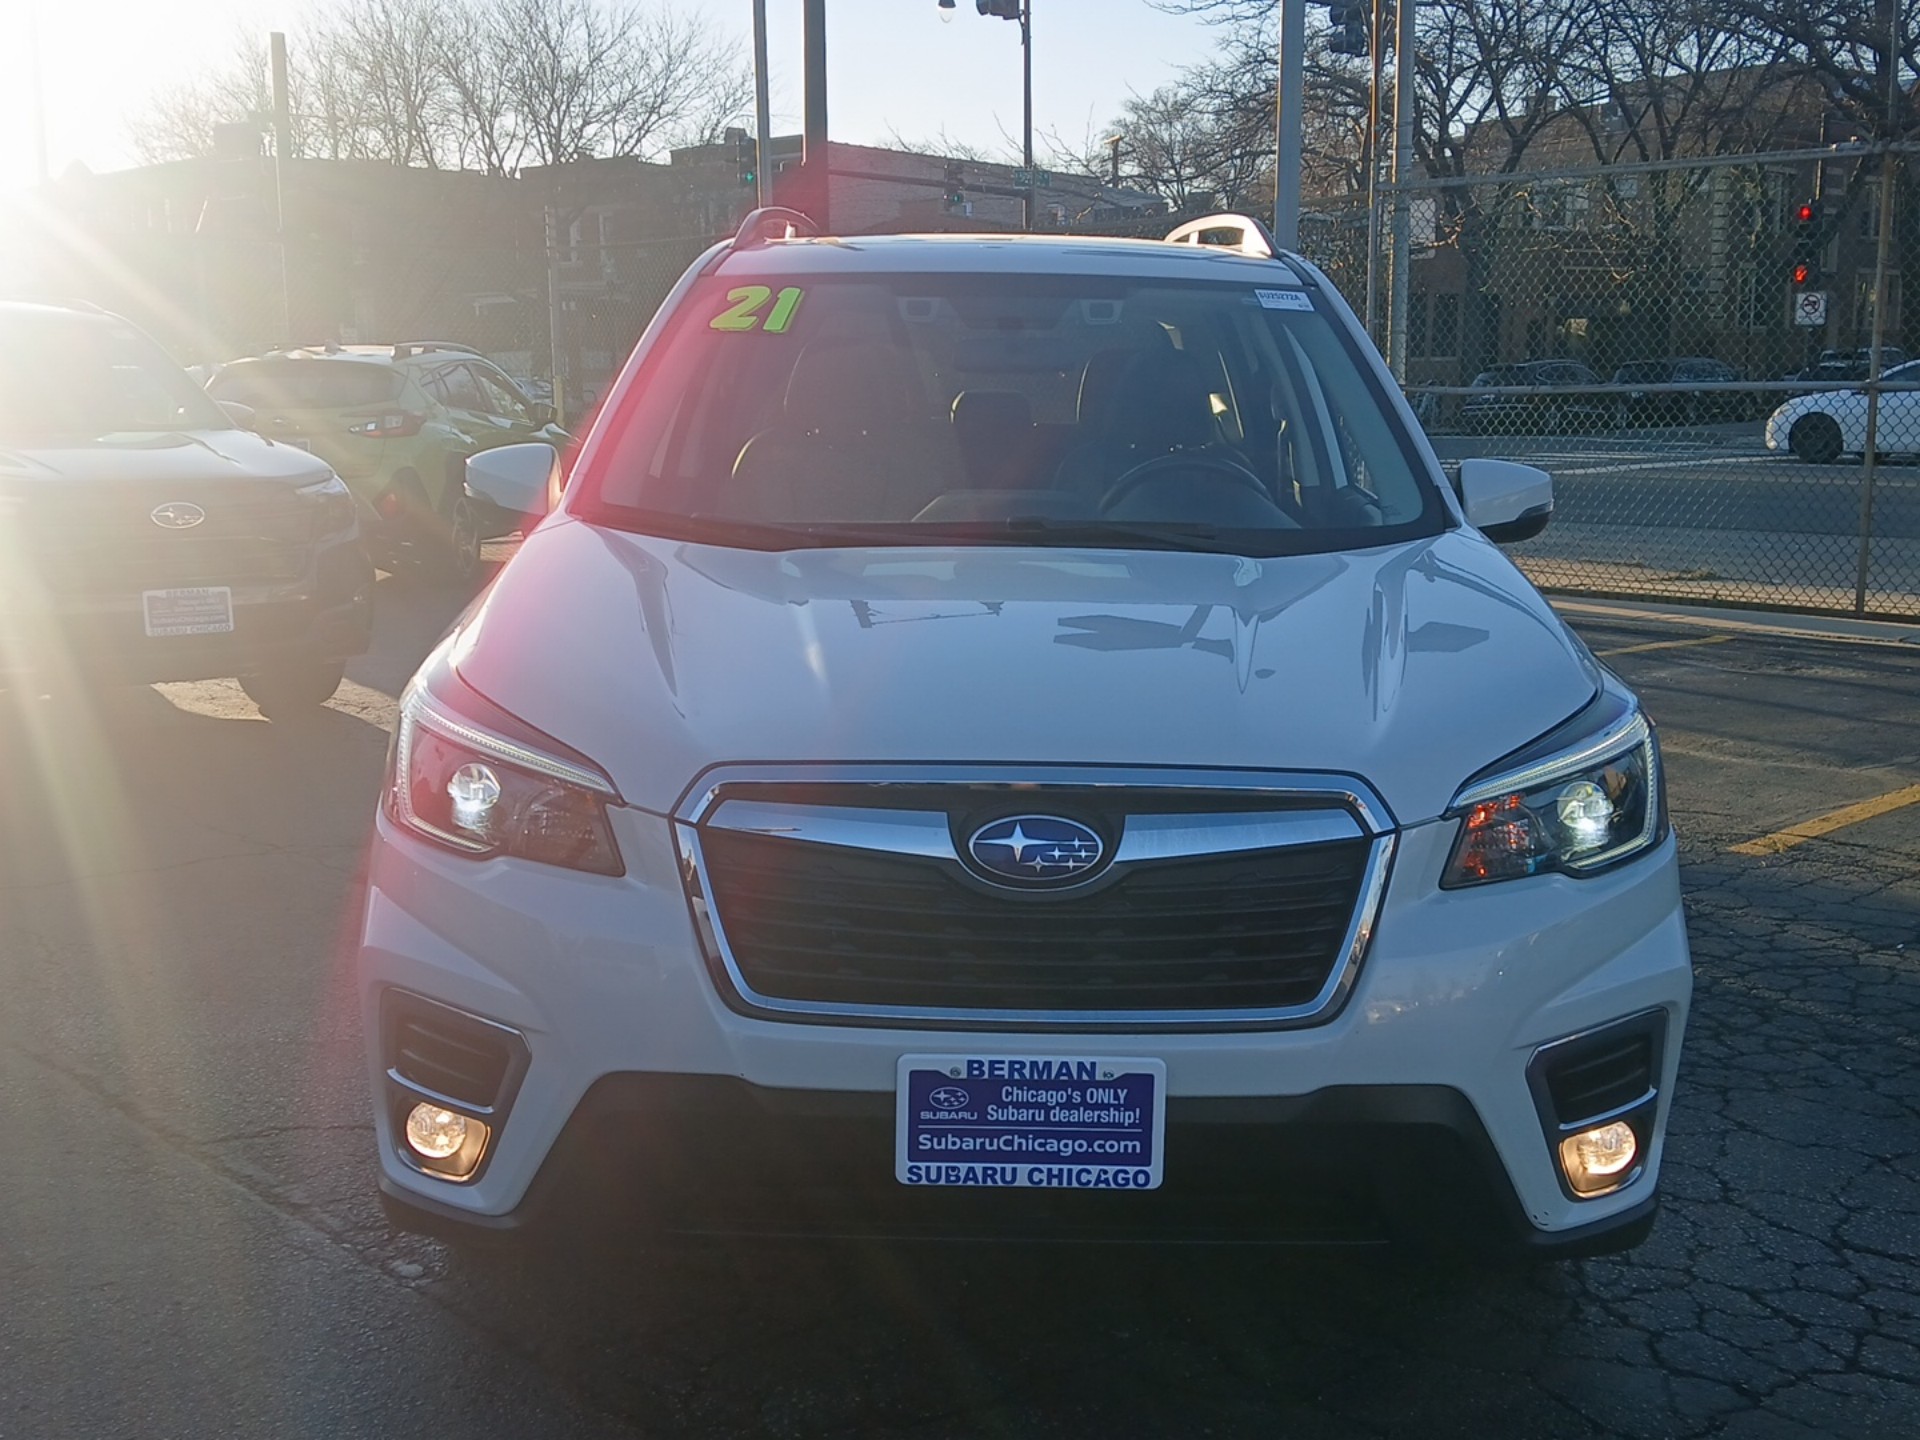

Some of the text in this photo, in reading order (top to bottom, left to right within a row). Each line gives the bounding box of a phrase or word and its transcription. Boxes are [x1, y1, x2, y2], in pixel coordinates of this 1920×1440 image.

[709, 285, 805, 333] 21
[966, 1059, 1097, 1081] BERMAN
[1001, 1085, 1128, 1106] Chicago's ONLY
[919, 1111, 978, 1121] SUBARU
[986, 1104, 1141, 1126] Subaru dealership!
[917, 1133, 1141, 1157] SubaruChicago.com
[906, 1164, 1151, 1188] SUBARU CHICAGO
